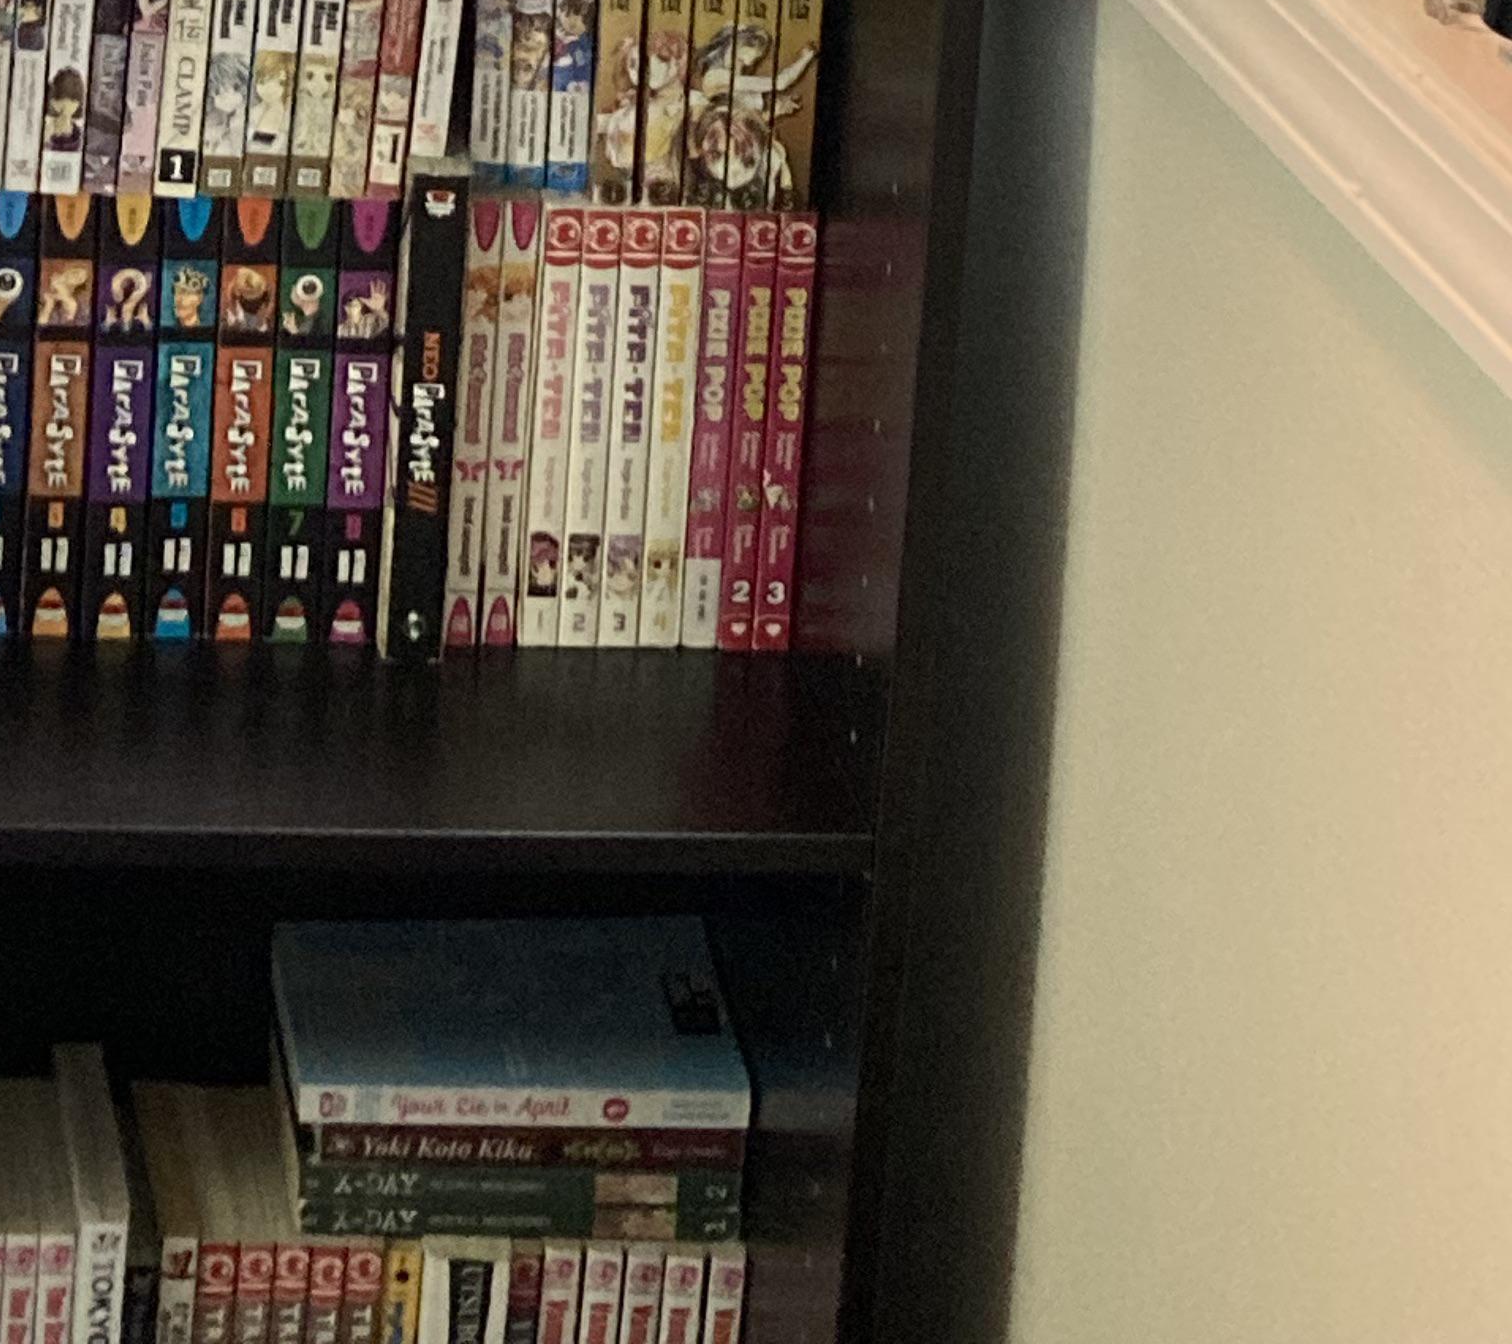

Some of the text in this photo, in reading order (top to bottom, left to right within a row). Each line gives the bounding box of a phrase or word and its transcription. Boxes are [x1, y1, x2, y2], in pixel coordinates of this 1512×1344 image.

[172, 57, 196, 135] CLAMP
[422, 332, 441, 381] NEO
[702, 366, 725, 421] POP
[742, 364, 766, 421] POP
[778, 365, 802, 422] POP
